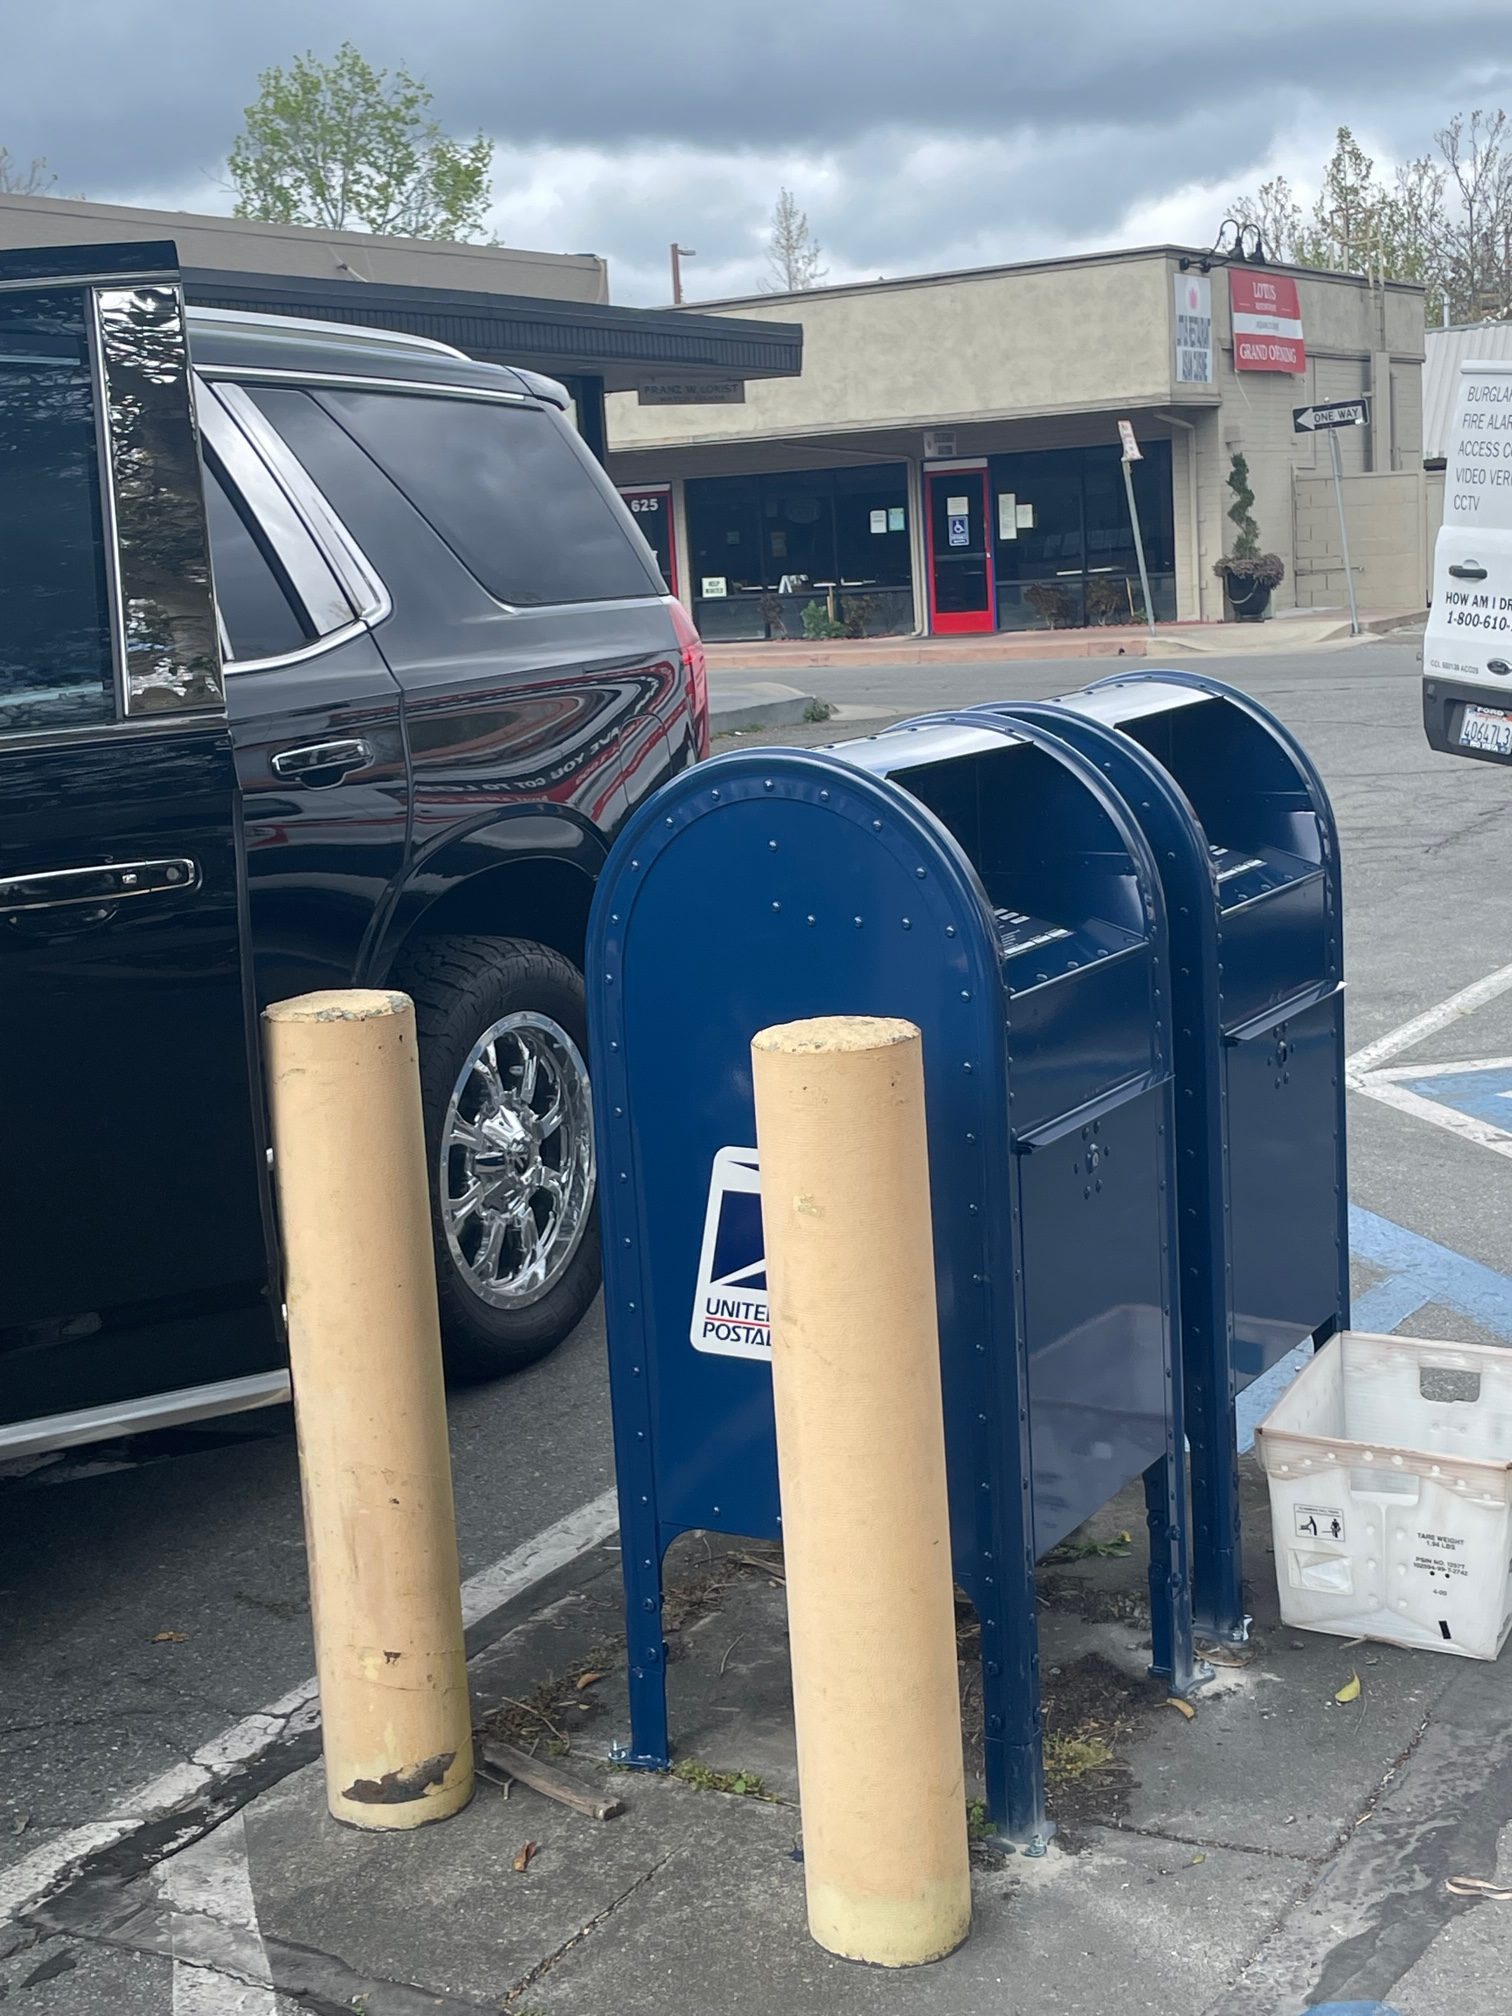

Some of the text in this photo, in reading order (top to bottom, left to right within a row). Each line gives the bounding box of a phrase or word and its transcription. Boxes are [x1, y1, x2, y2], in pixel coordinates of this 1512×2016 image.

[1239, 343, 1267, 360] GRAND
[1314, 408, 1359, 423] ONE WAY
[1462, 413, 1486, 430] FIRE
[1458, 440, 1500, 458] ACCESS
[1456, 468, 1487, 485] VIDEO
[631, 498, 658, 512] 625
[1454, 494, 1480, 511] CCTV
[1445, 592, 1469, 606] HOW
[1472, 594, 1489, 609] AM
[1477, 706, 1504, 716] FORD
